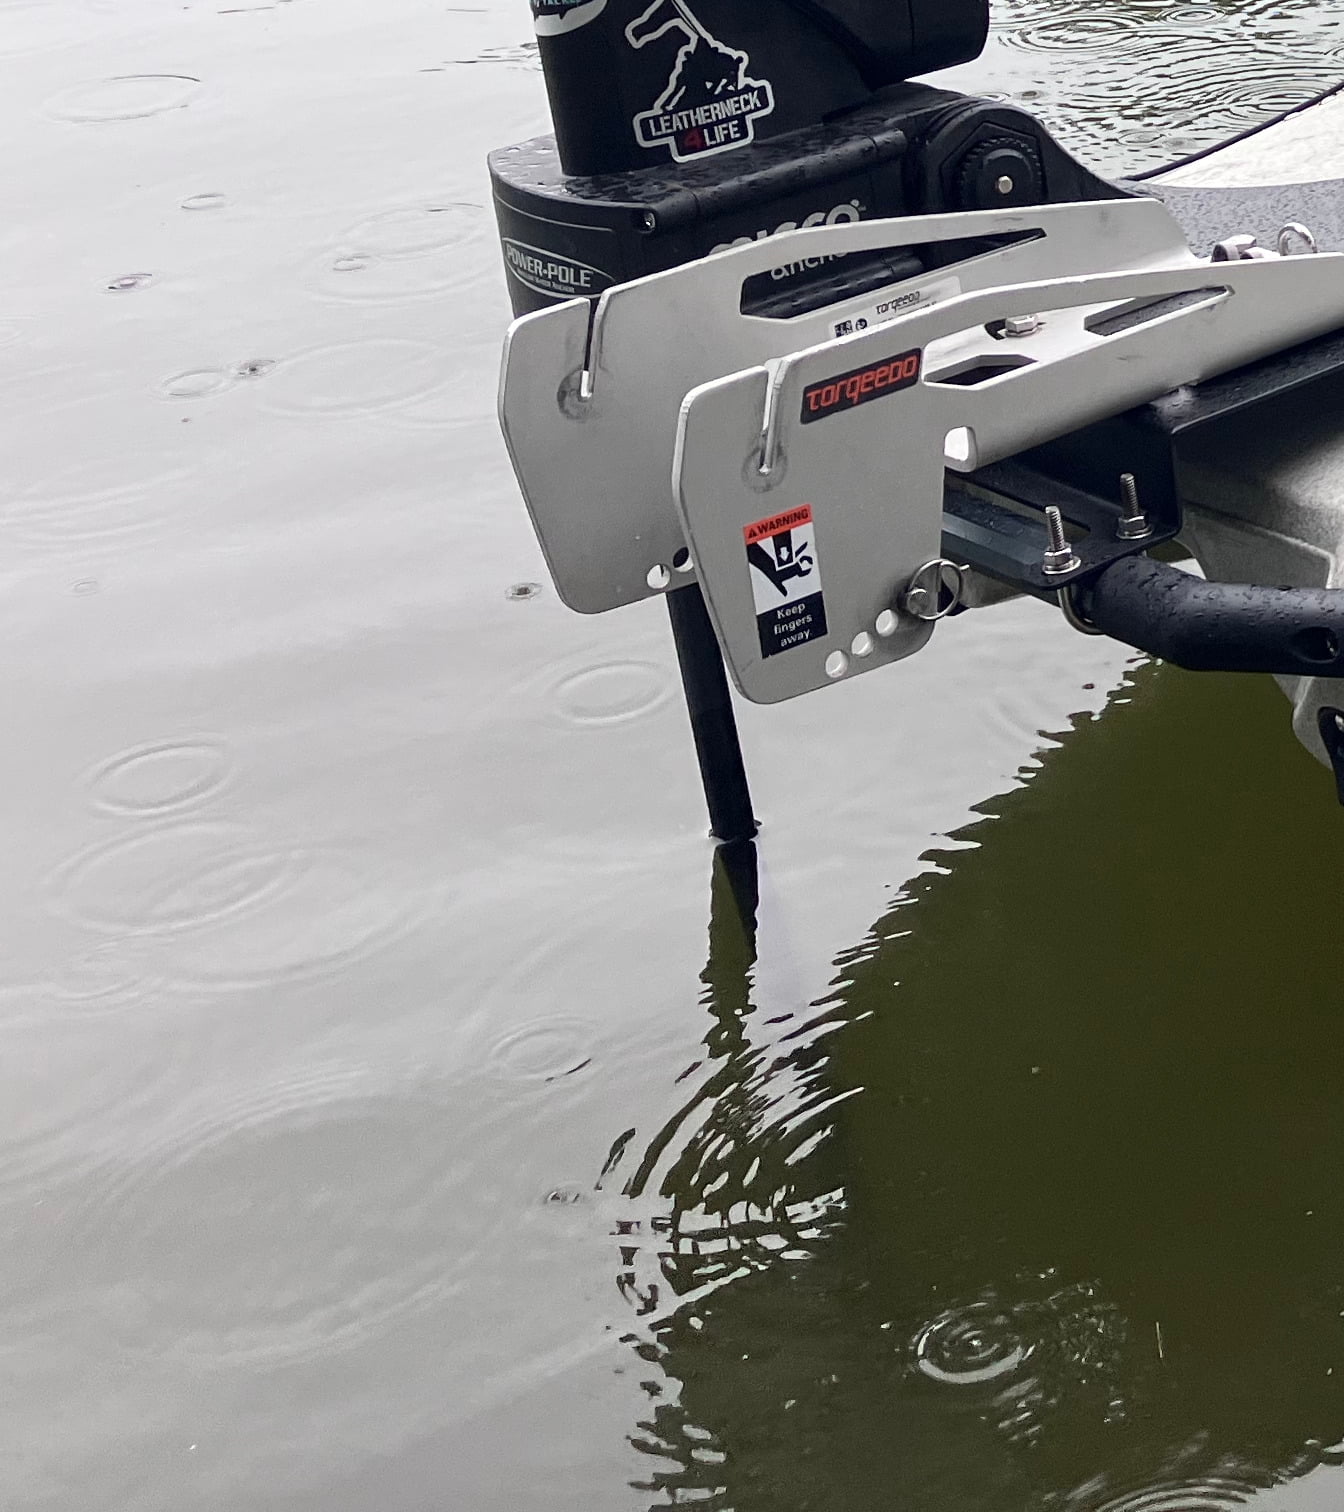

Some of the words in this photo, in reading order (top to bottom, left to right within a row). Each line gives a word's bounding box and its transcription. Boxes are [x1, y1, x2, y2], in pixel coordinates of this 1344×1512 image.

[649, 90, 762, 137] LEATHERNECK
[704, 120, 741, 147] LIFE
[505, 243, 595, 288] POWER-POLE
[757, 508, 809, 534] WARNING
[773, 614, 813, 634] fingers
[776, 603, 806, 619] Keep
